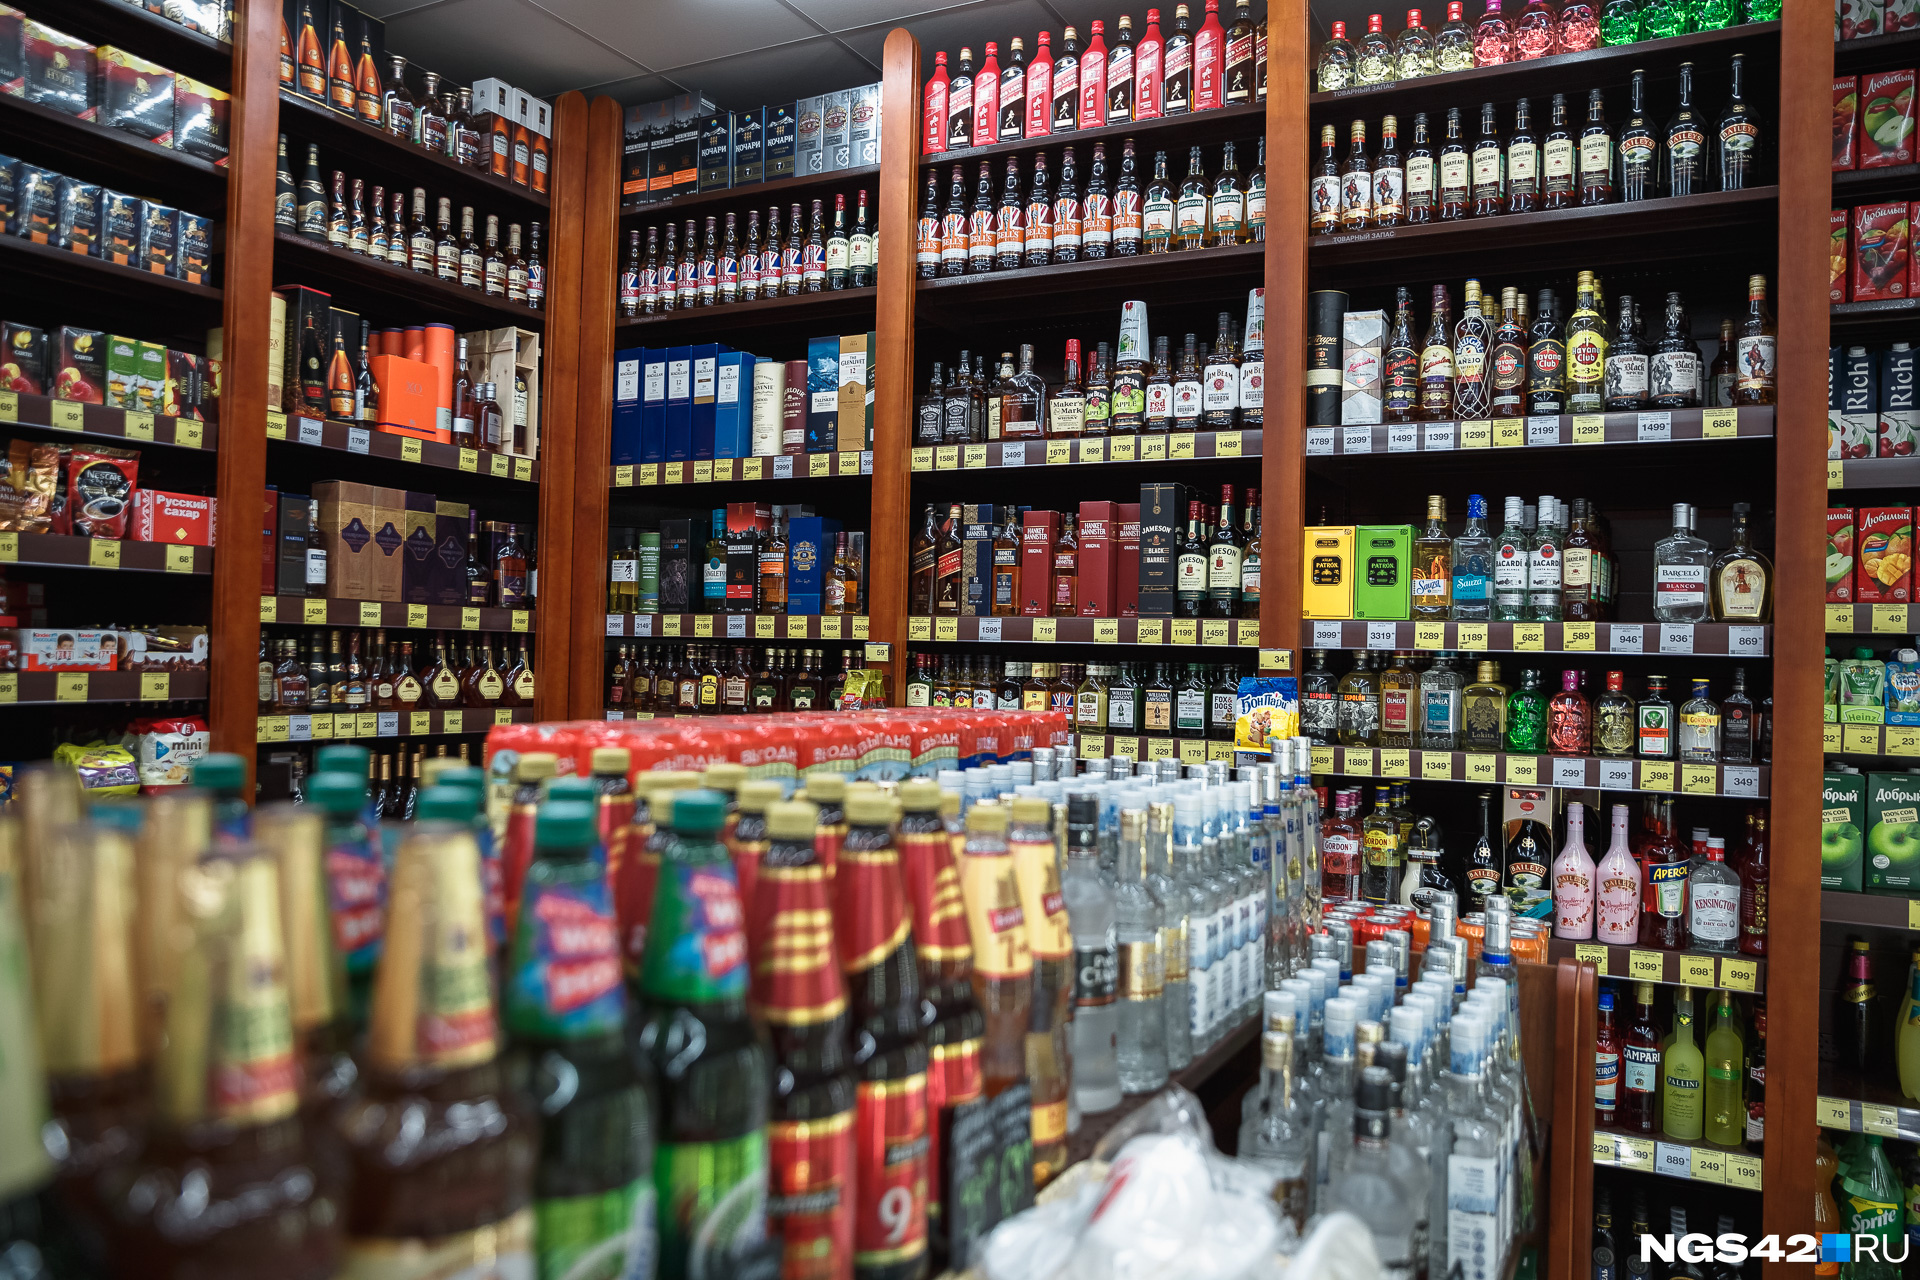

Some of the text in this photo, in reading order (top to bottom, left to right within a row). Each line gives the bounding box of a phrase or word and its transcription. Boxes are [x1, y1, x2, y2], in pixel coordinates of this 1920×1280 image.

[1333, 82, 1395, 97] ТОВАРНЫЙ ЗАПАС
[1721, 125, 1756, 138] BAILEYS
[1669, 132, 1702, 145] BAILEYS
[1621, 138, 1654, 151] BAILEYS
[1333, 231, 1395, 243] ТОВАРНЫЙ ЗАПАС
[1572, 346, 1600, 355] Havana
[1534, 353, 1560, 362] Havana
[1577, 354, 1596, 362] Club
[1624, 362, 1645, 371] Black
[1674, 360, 1695, 368] Black
[1206, 369, 1233, 382] JIM BEAM
[1396, 377, 1401, 385] 7
[1544, 377, 1550, 386] 7
[1846, 361, 1868, 410] Rich
[1890, 358, 1912, 408] Rich
[1150, 399, 1165, 407] red
[156, 495, 208, 511] Русский
[164, 507, 200, 520] сахар
[1860, 511, 1909, 531] Любимый
[1142, 525, 1172, 534] JAMESON
[1178, 557, 1204, 565] JAMESON
[1496, 559, 1522, 567] BACARDÍ
[1662, 568, 1700, 577] BARCELÓ
[1456, 578, 1482, 588] Sauza
[1849, 712, 1876, 722] Heinz
[172, 739, 202, 750] mini
[1468, 870, 1499, 881] BAILEYS
[1510, 865, 1545, 876] BAILEYS
[1654, 866, 1688, 880] APEROL
[1694, 899, 1736, 910] KENSINGTON
[1667, 1078, 1699, 1088] PALLINI
[878, 1186, 912, 1244] 9
[1851, 1208, 1896, 1234] Sprite
